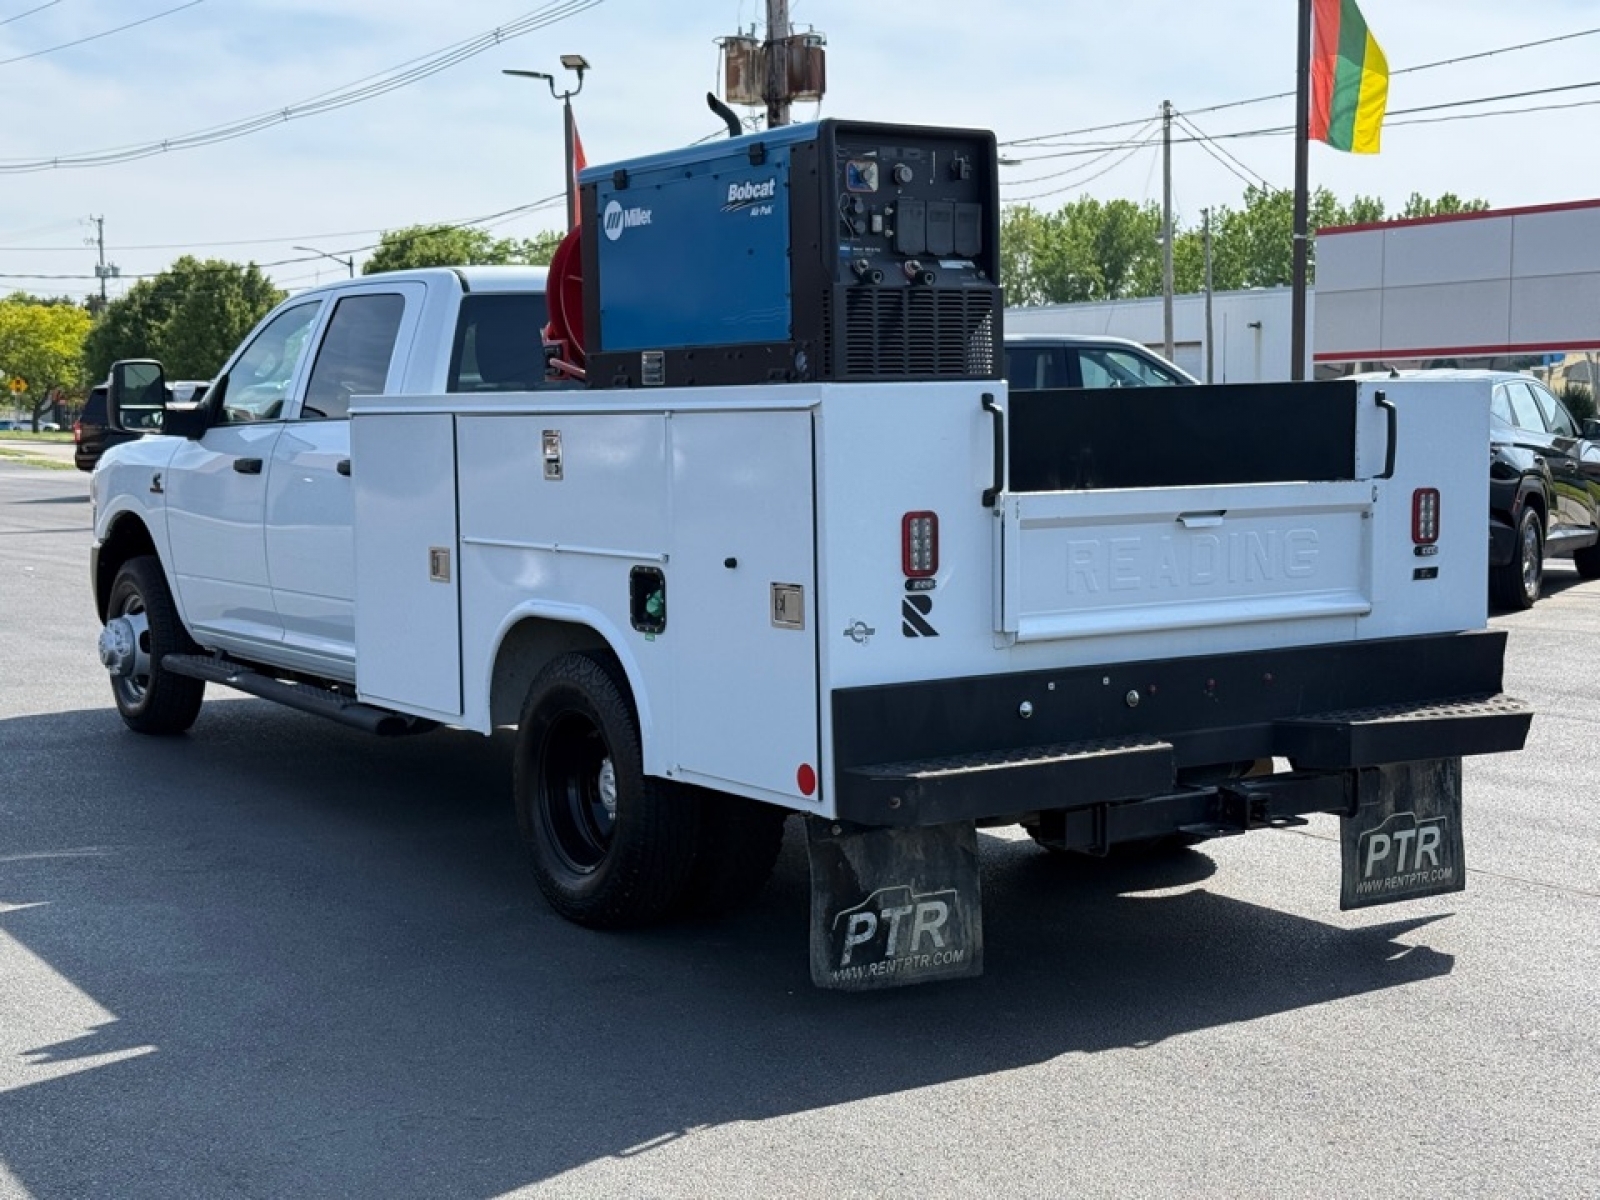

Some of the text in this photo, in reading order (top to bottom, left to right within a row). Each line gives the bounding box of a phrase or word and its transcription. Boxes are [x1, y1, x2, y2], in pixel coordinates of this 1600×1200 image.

[728, 178, 776, 201] Bobcat
[624, 207, 652, 228] Miller
[1064, 528, 1320, 595] READING
[1364, 826, 1440, 877] PTR
[1356, 867, 1452, 894] WWW.RENTPTR.COM
[841, 901, 948, 966] PTR
[831, 949, 964, 982] WWW.RENTPTR.COM
